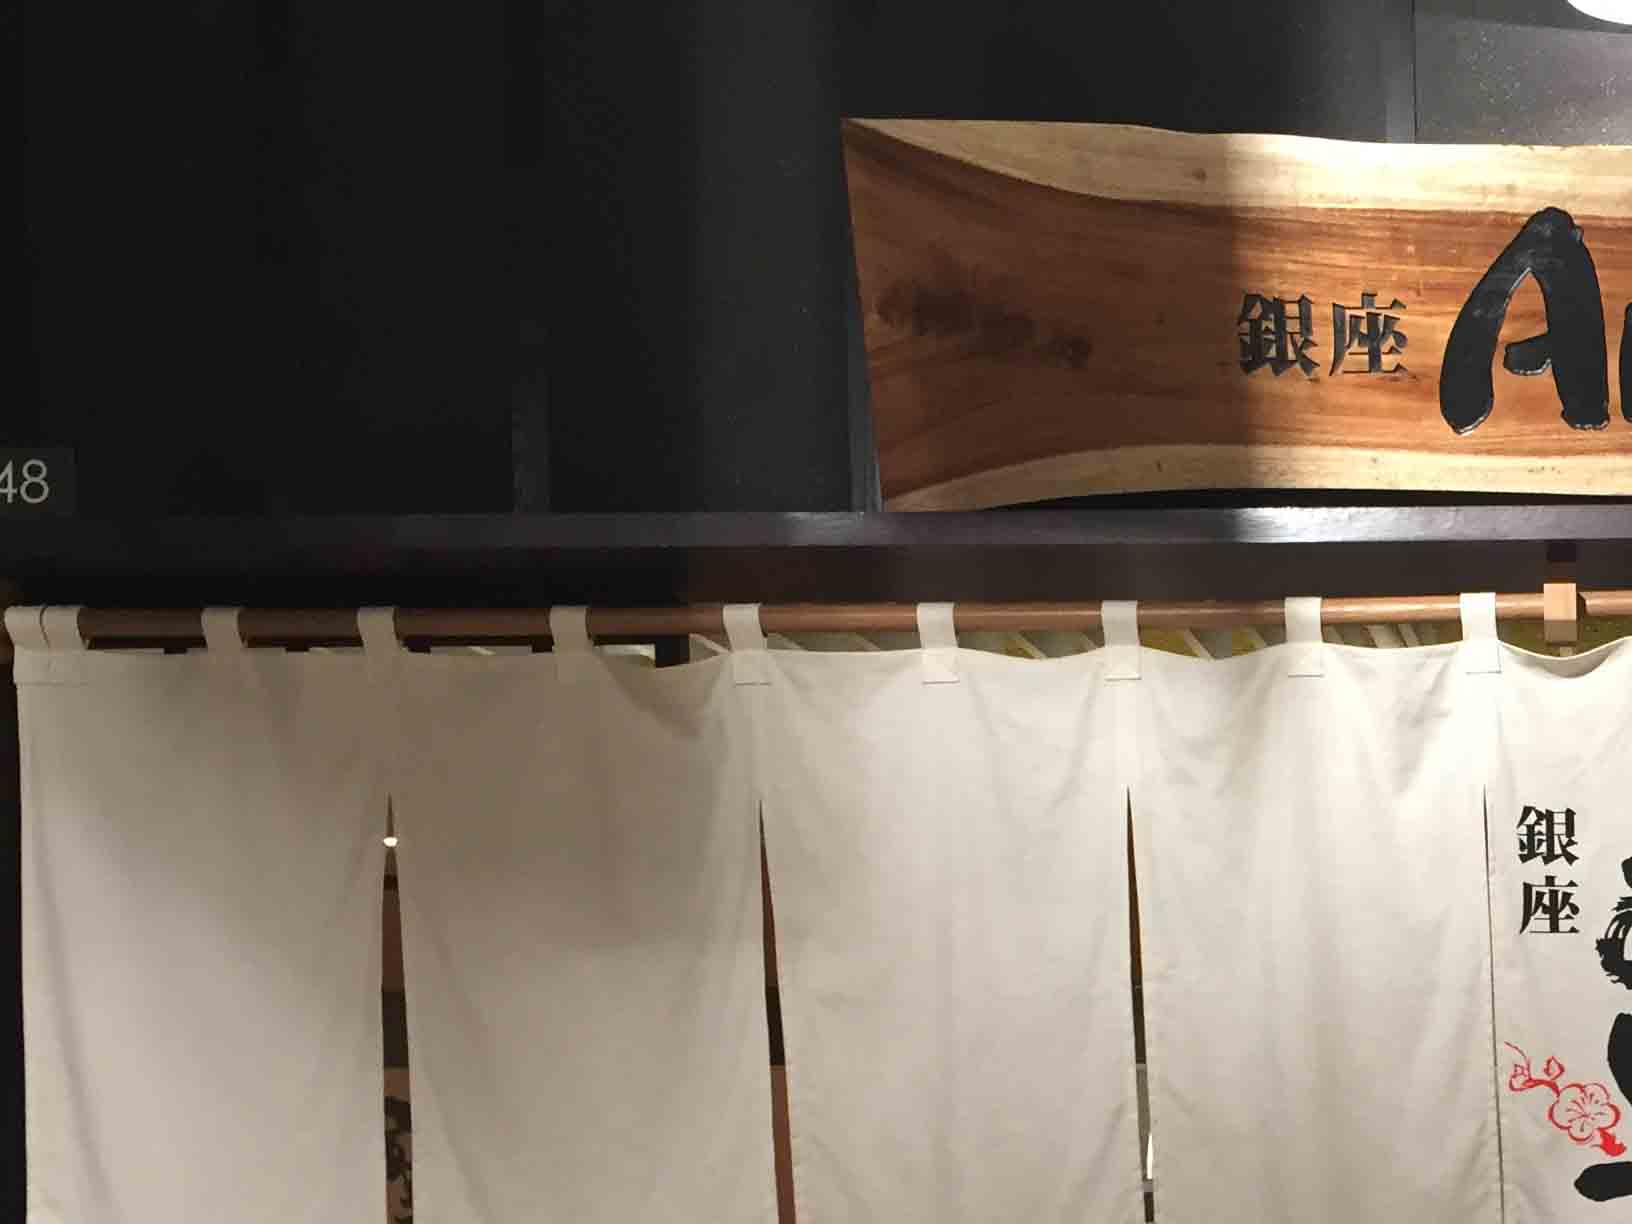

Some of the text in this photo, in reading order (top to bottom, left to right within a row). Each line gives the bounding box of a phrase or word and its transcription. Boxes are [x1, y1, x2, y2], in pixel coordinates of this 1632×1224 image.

[1236, 290, 1408, 378] 銀座
[0, 458, 49, 503] 48
[1516, 805, 1580, 935] 銀座
